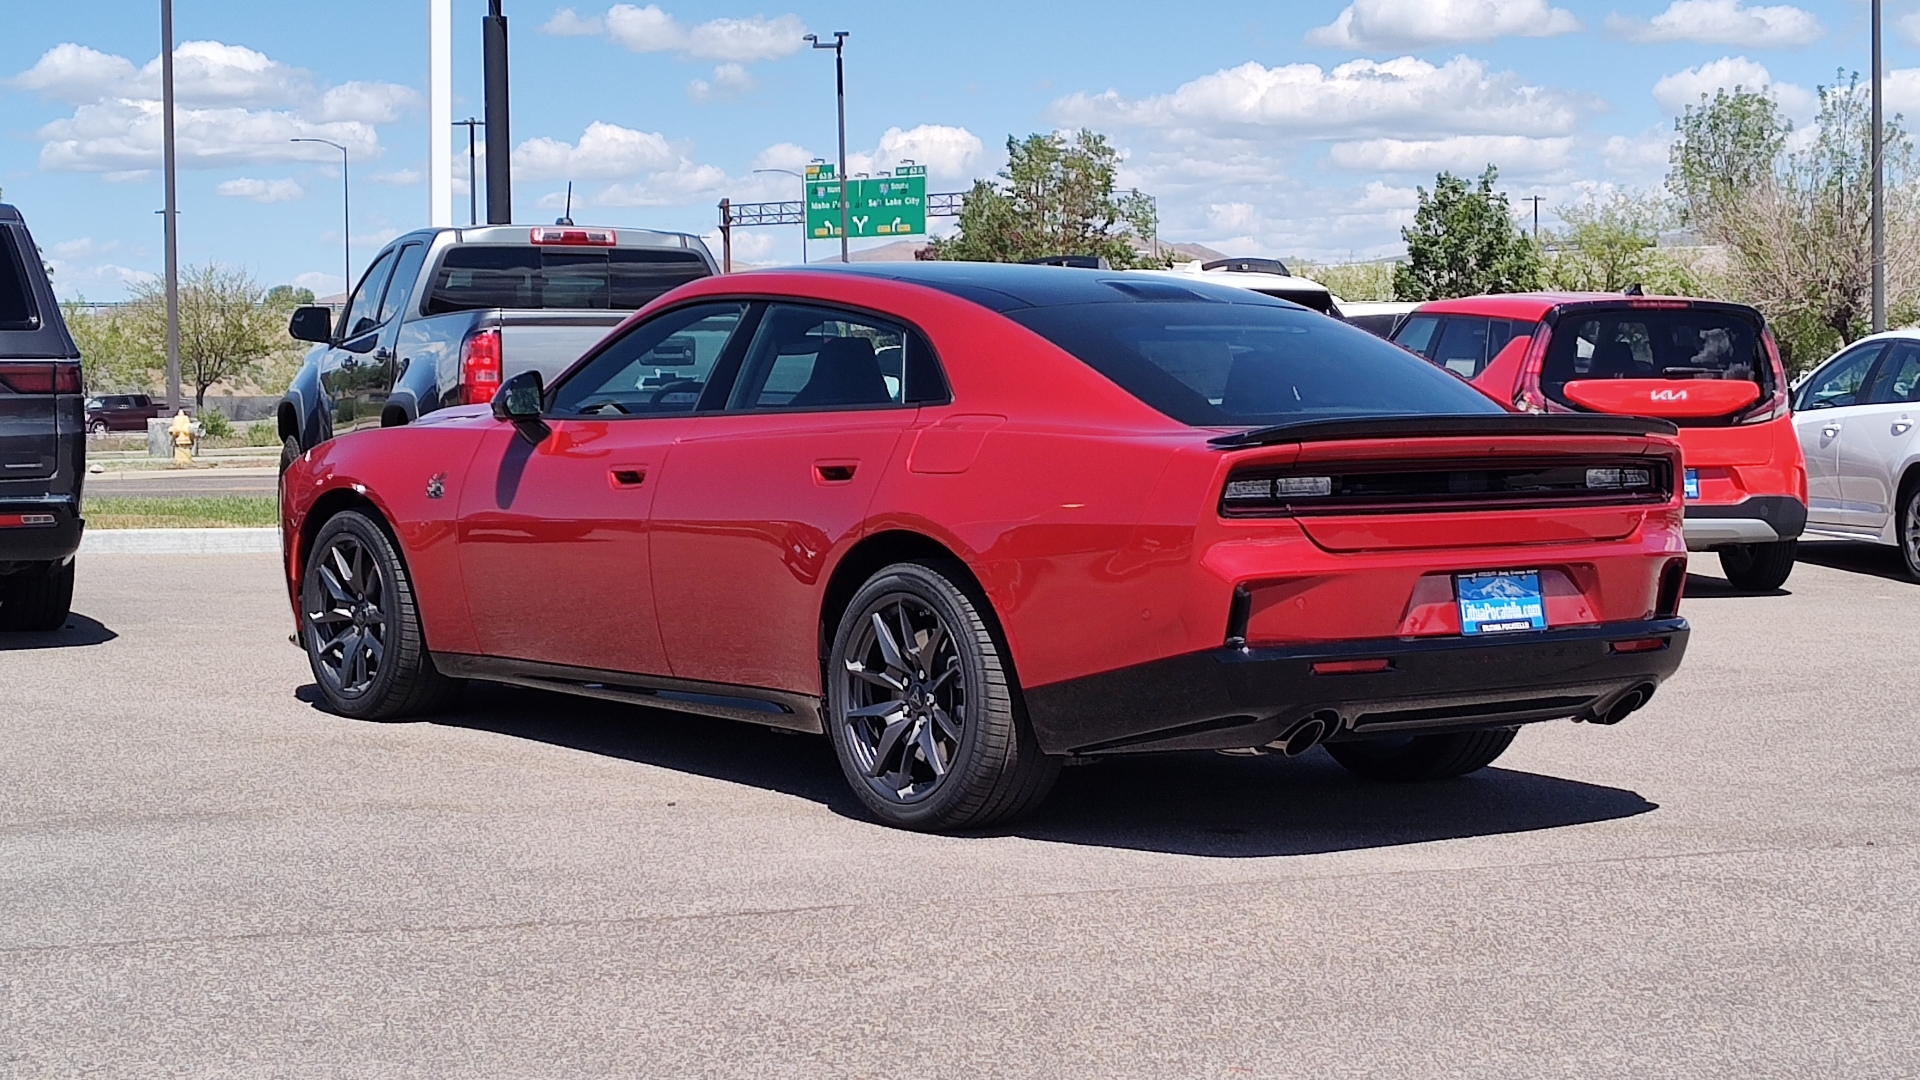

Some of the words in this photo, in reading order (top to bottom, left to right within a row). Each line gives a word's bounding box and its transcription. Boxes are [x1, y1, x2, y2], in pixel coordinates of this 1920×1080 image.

[811, 201, 830, 209] Idaho
[885, 198, 902, 206] Lake
[905, 197, 919, 207] City
[1651, 389, 1687, 400] KIA
